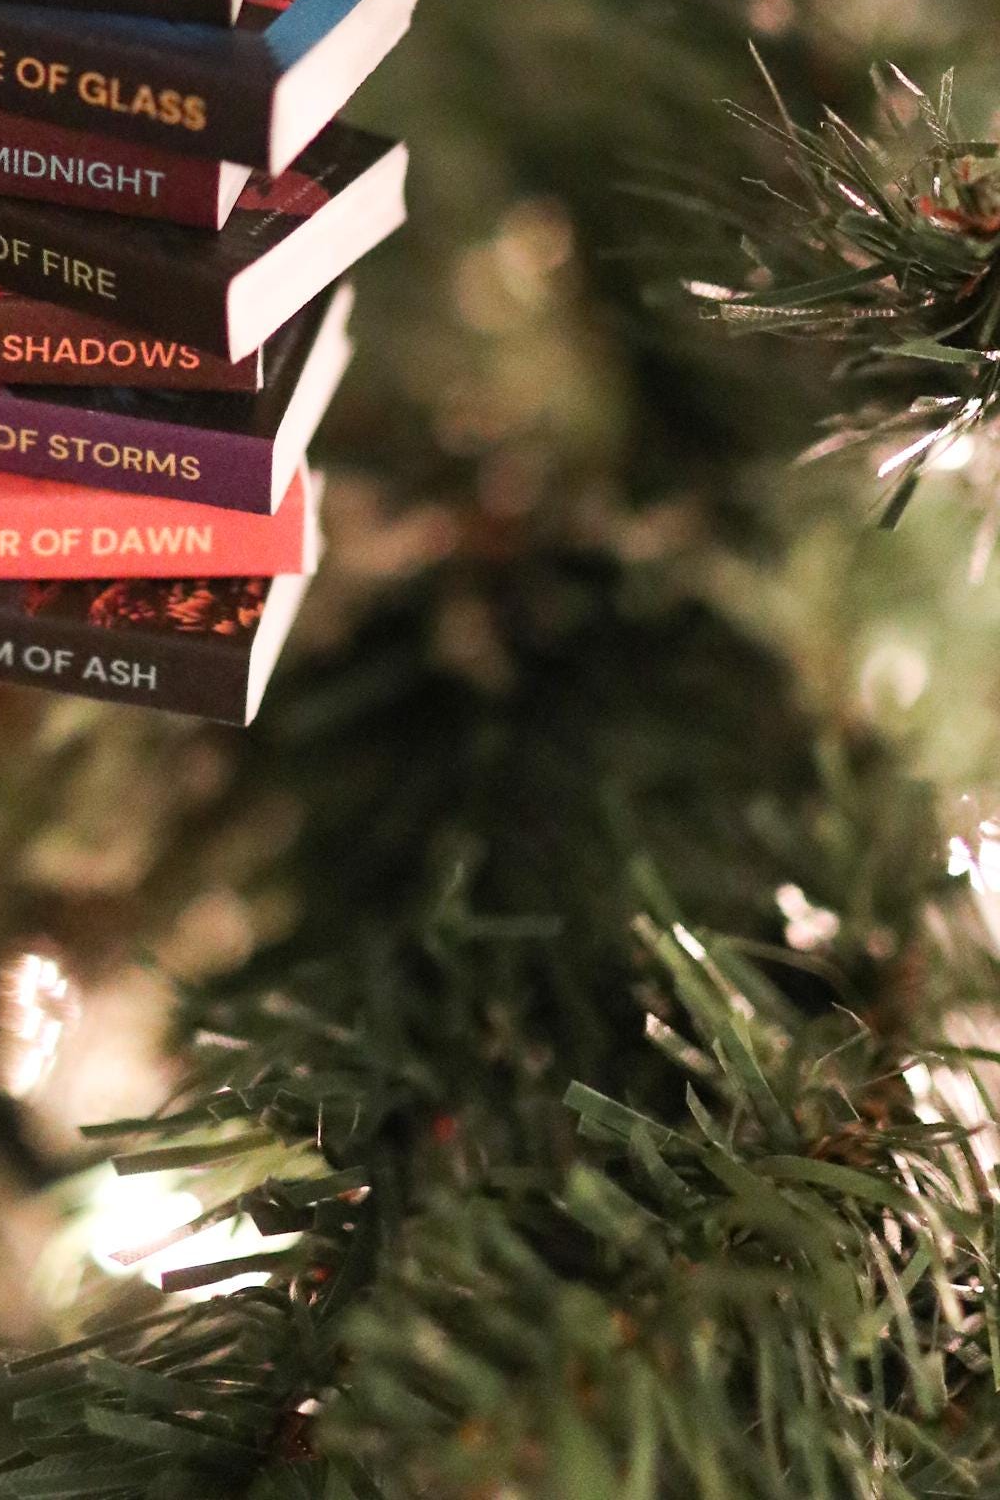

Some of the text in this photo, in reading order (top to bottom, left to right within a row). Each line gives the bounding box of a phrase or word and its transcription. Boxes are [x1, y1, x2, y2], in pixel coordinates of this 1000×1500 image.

[16, 58, 68, 93] OF
[78, 72, 205, 130] GLASS
[43, 249, 117, 300] FIRE
[2, 334, 200, 369] SHADOWS
[49, 434, 200, 480] STORMS
[31, 528, 82, 556] OF
[92, 526, 211, 555] DAWN
[23, 646, 73, 673] OF
[83, 657, 156, 689] ASH
